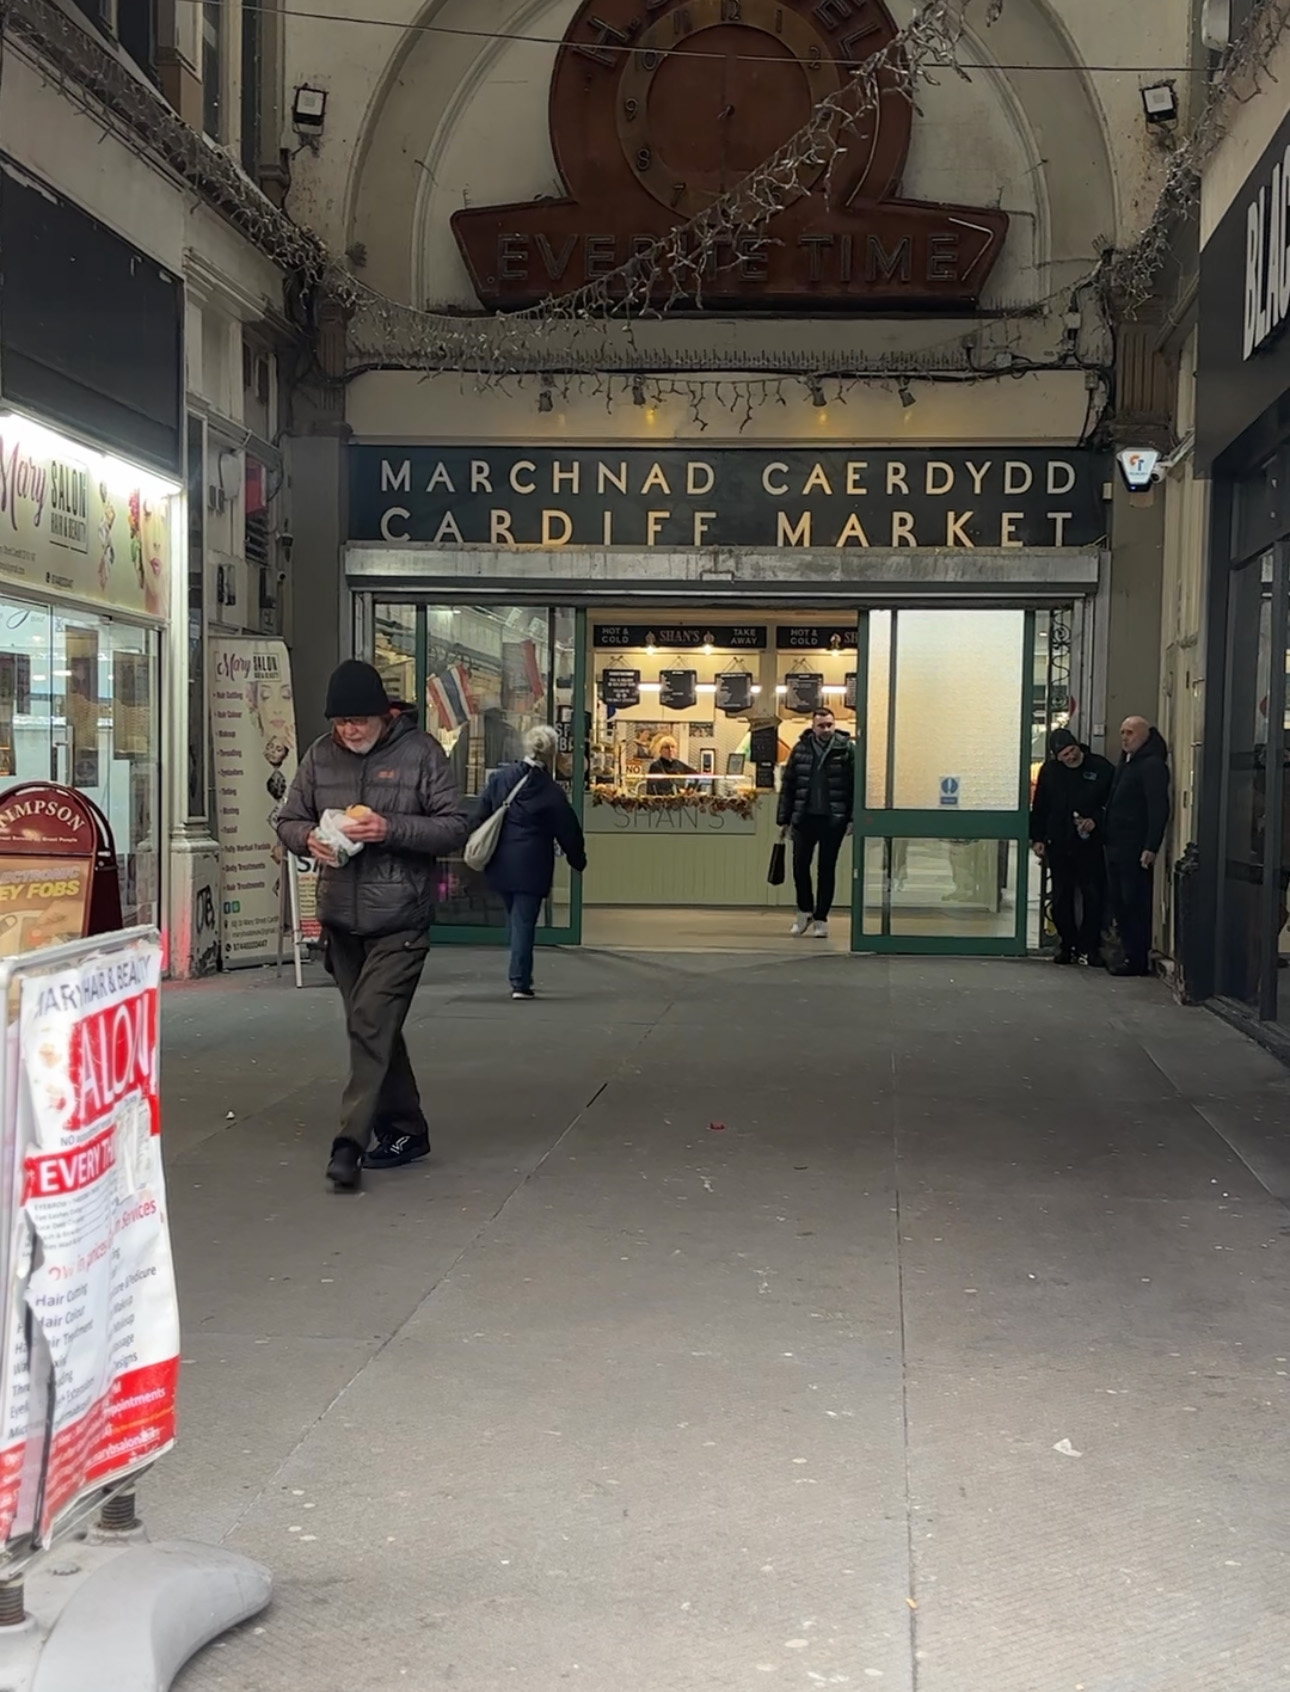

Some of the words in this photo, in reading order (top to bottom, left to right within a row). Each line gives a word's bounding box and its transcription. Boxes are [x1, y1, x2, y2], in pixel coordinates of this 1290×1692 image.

[625, 98, 639, 122] 9
[636, 147, 650, 171] 8
[497, 233, 769, 283] EVERITE
[798, 233, 960, 283] TIME
[381, 459, 715, 495] MARCHNAD
[762, 461, 1076, 496] CAERDYDD
[51, 461, 87, 519] SALON
[380, 507, 718, 547] CARDIFF
[776, 511, 1074, 548] MARKET
[602, 627, 622, 635] HOT
[659, 630, 701, 643] SHAN'S
[733, 629, 757, 637] TAKE
[790, 629, 810, 637] HOT
[601, 636, 629, 644] COLD
[731, 637, 758, 645] AWAY
[790, 637, 818, 645] COLD
[626, 765, 640, 774] NO
[614, 804, 725, 829] SHANS
[26, 881, 81, 899] FOBS
[61, 1135, 75, 1147] NO
[39, 1142, 100, 1193] EVERY
[35, 1293, 64, 1307] Hair
